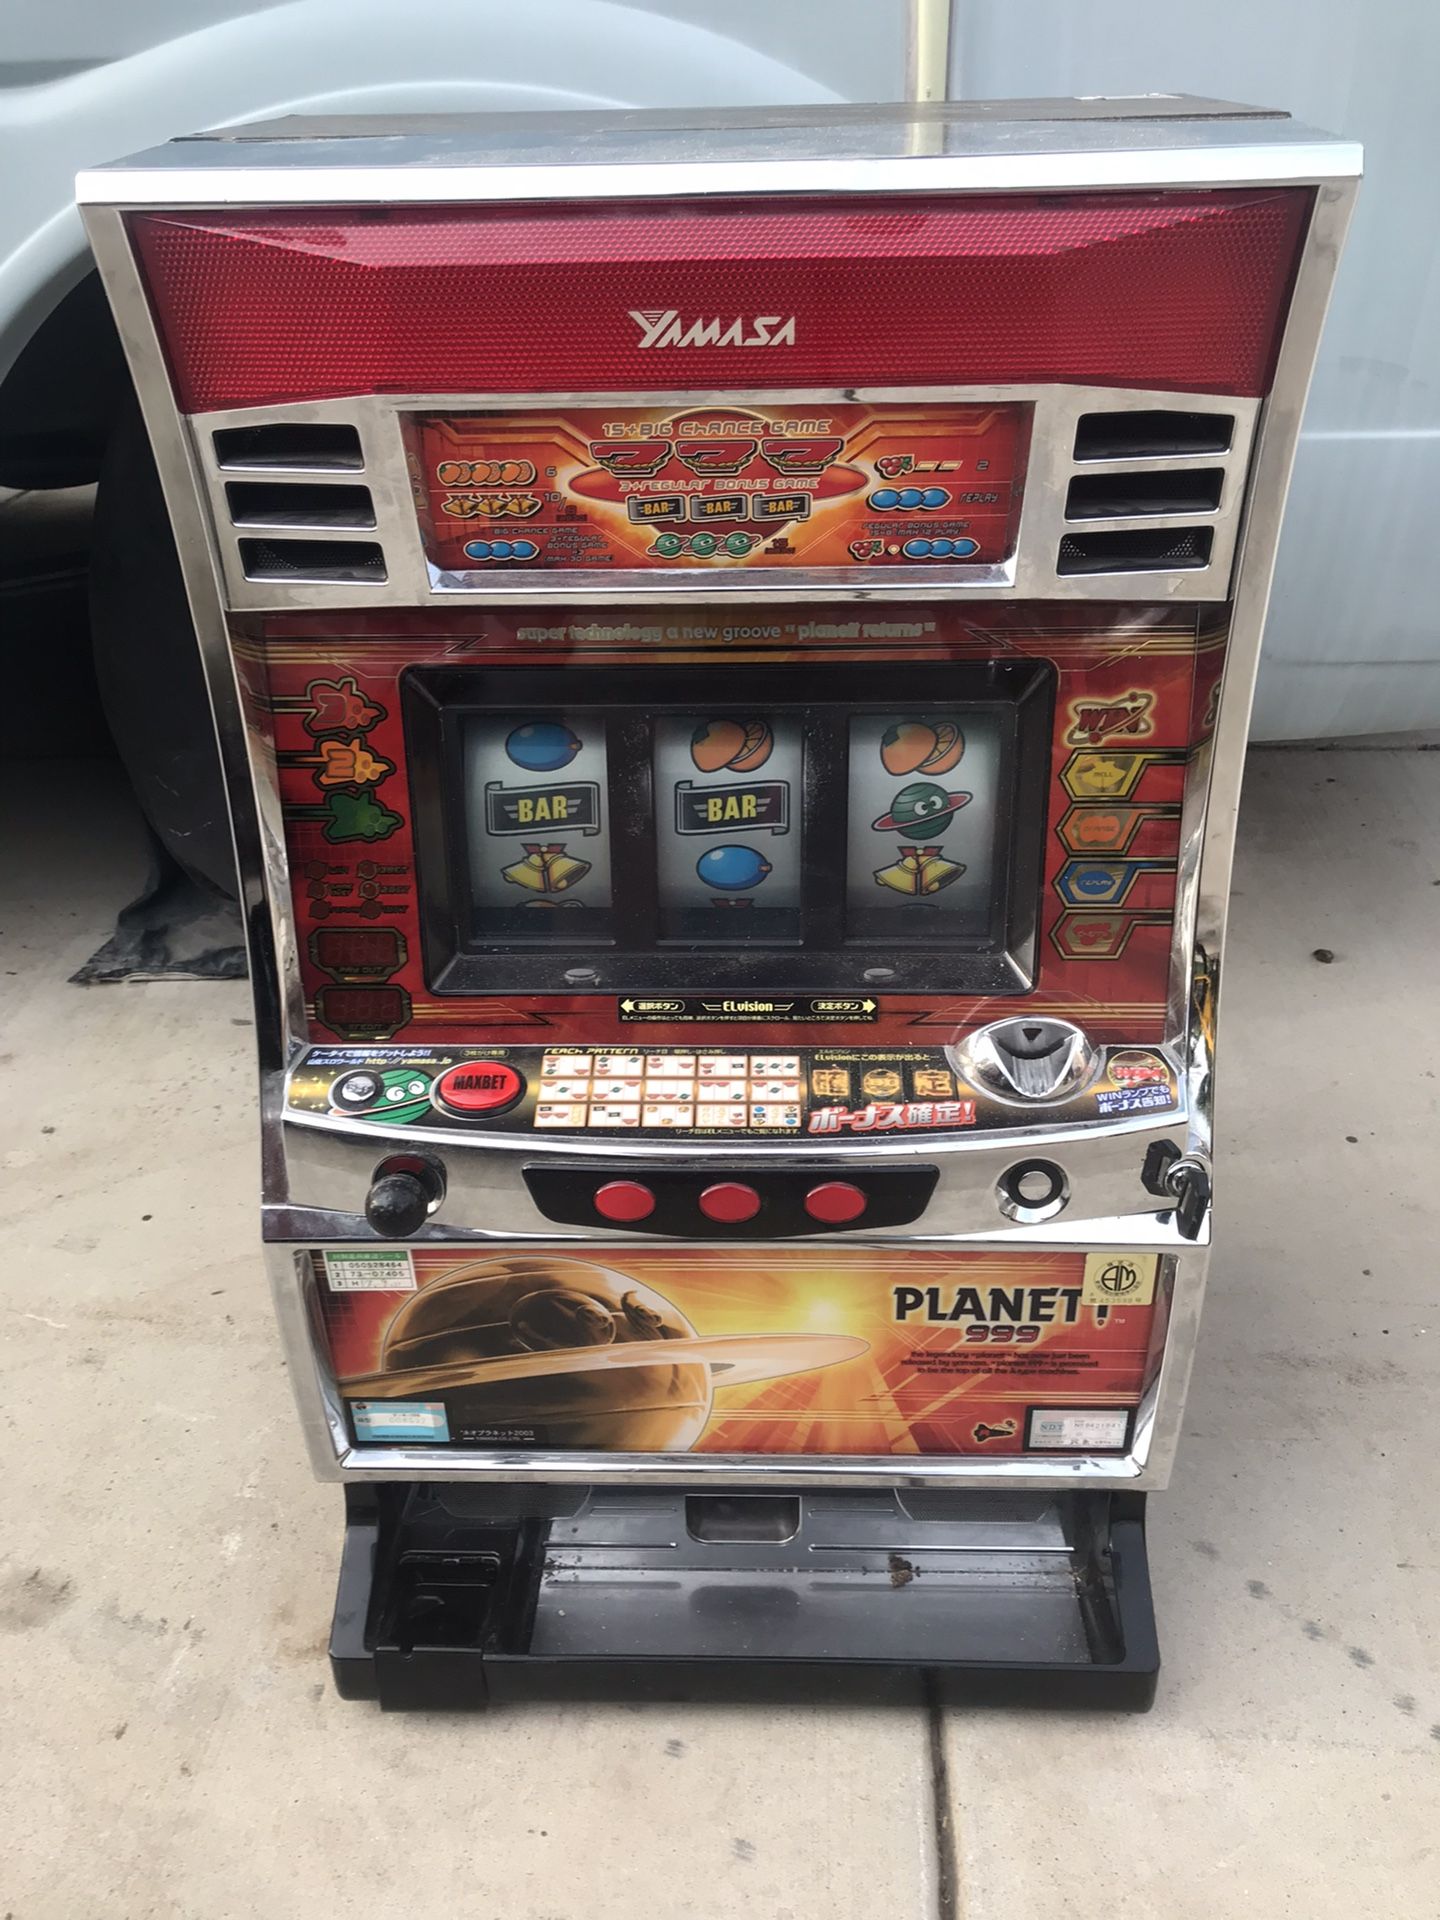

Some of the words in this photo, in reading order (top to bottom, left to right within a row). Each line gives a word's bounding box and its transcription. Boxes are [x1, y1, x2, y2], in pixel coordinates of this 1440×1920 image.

[628, 310, 796, 348] YAMASA
[679, 420, 765, 436] CHANCE
[769, 418, 832, 435] GAME
[975, 460, 989, 471] 2
[713, 479, 770, 491] BONUS
[772, 477, 821, 490] GAME
[643, 502, 670, 516] BAR
[705, 501, 732, 515] BAR
[768, 500, 795, 514] BAR
[517, 626, 567, 642] super
[569, 624, 663, 642] technology
[666, 627, 679, 639] a
[682, 627, 718, 639] new
[722, 625, 782, 641] groove
[517, 795, 569, 822] BAR
[707, 795, 758, 822] BAR
[722, 1001, 774, 1012] ELvision
[586, 1047, 640, 1055] PATTERN
[453, 1074, 508, 1091] MAXBET
[965, 1325, 1041, 1343] 999
